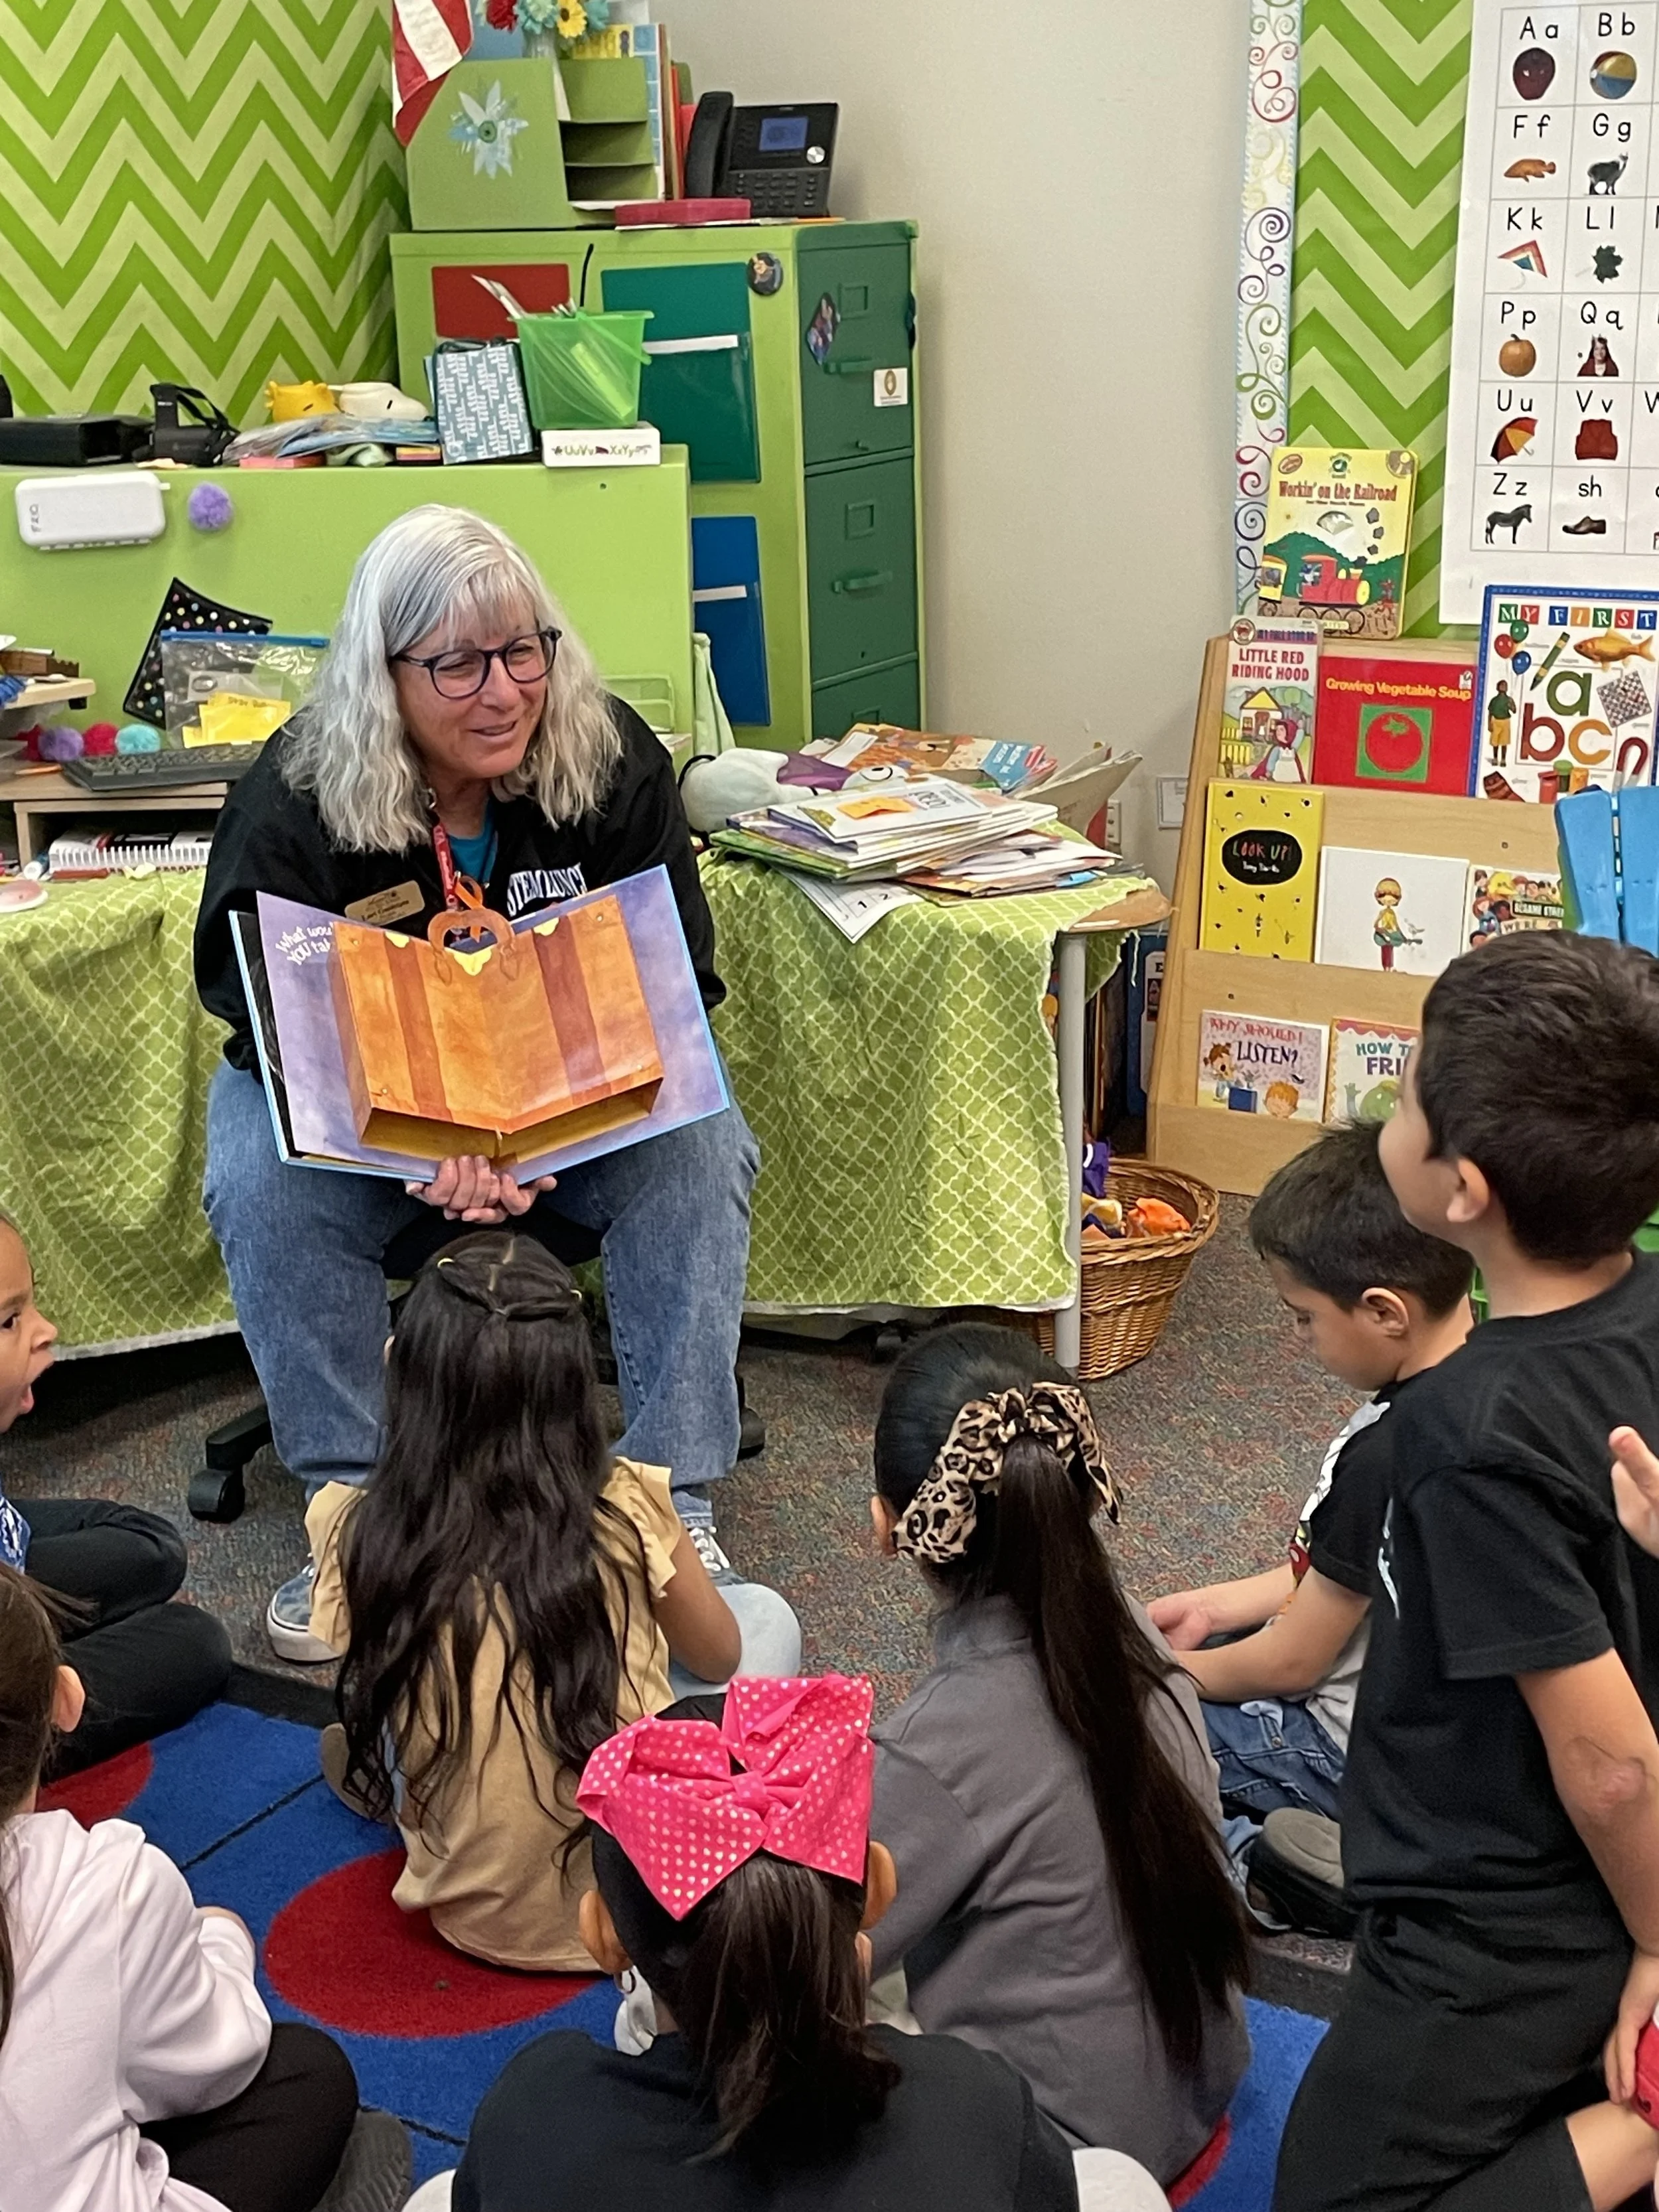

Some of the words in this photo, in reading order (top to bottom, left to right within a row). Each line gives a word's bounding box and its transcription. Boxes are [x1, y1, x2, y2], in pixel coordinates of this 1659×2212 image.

[1318, 485, 1331, 498] on
[1334, 482, 1351, 500] the
[1354, 482, 1398, 502] Railroad
[1578, 475, 1602, 498] sh
[1499, 605, 1539, 623] MY
[1553, 607, 1656, 628] FIRST
[1239, 648, 1277, 663] LITTLE
[1281, 651, 1305, 664] RED
[1232, 664, 1273, 680] RIDING
[1275, 666, 1309, 682] HOOD
[1325, 677, 1376, 696] Growing
[1376, 681, 1437, 698] Vegetable
[1437, 686, 1472, 701] Soup
[1232, 840, 1266, 859] LOOK
[275, 926, 307, 953] What
[287, 942, 312, 966] YOU
[1209, 1017, 1240, 1033] WHY
[1243, 1023, 1297, 1043] SHOULD
[1236, 1040, 1299, 1069] LISTEN?
[1356, 1042, 1393, 1057] HOW
